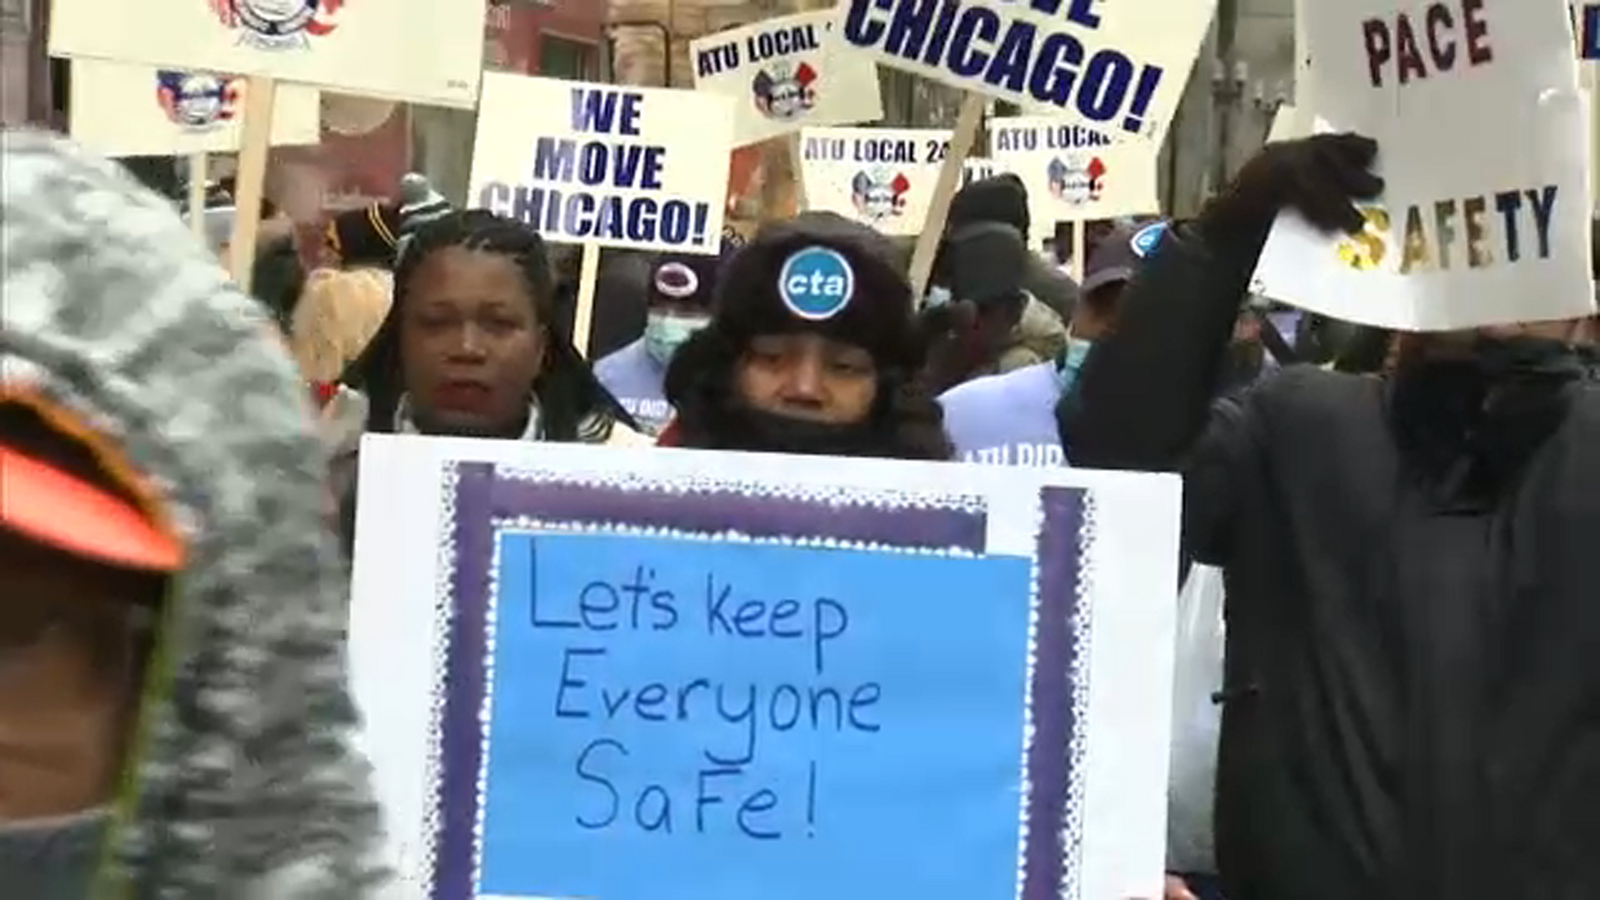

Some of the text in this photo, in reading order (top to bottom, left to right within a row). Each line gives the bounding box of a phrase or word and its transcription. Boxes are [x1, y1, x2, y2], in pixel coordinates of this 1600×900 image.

[697, 24, 820, 78] ATU LOCAL
[844, 0, 1163, 133] CHICAGO!
[1362, 0, 1492, 87] PACE
[571, 88, 643, 136] WE
[998, 127, 1037, 150] ATU
[534, 136, 666, 190] MOVE
[805, 137, 845, 160] ATU
[853, 139, 917, 163] LOCAL
[480, 182, 709, 246] CHICAGO!
[1336, 186, 1558, 274] SAFETY
[788, 269, 844, 296] cta
[530, 538, 679, 632] Let's
[555, 648, 882, 766] Everyone
